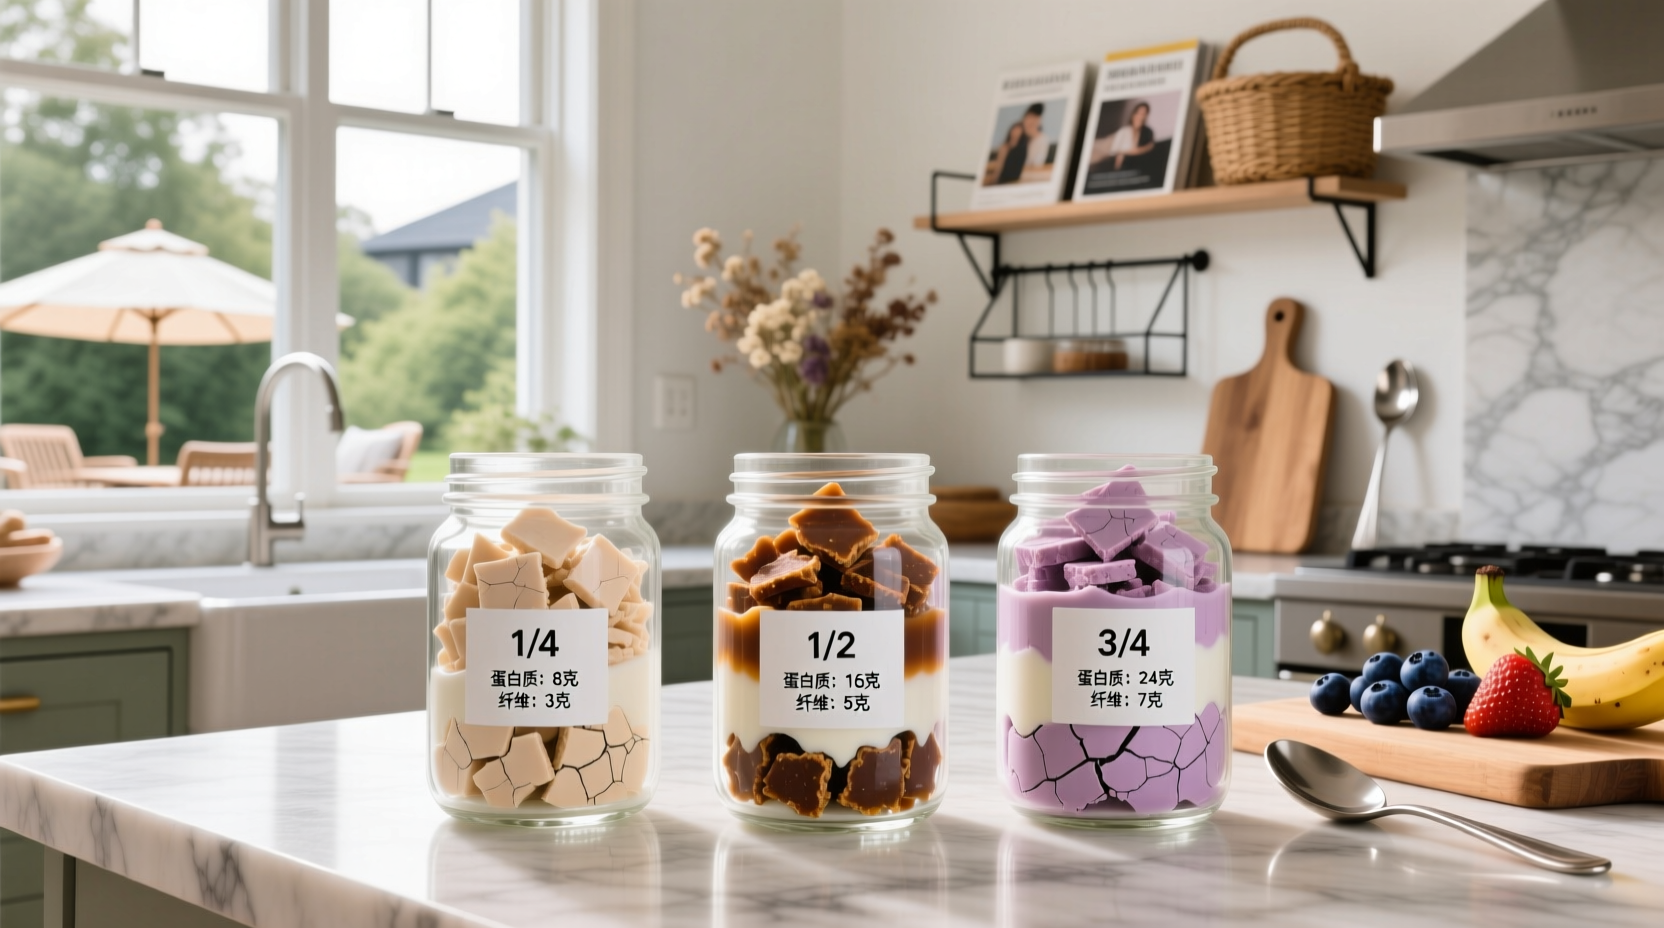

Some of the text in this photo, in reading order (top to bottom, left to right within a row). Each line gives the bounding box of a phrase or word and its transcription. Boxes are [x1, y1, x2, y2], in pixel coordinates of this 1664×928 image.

[511, 627, 560, 659] 1/4
[808, 629, 856, 661] 1/2
[1097, 627, 1151, 659] 3/4
